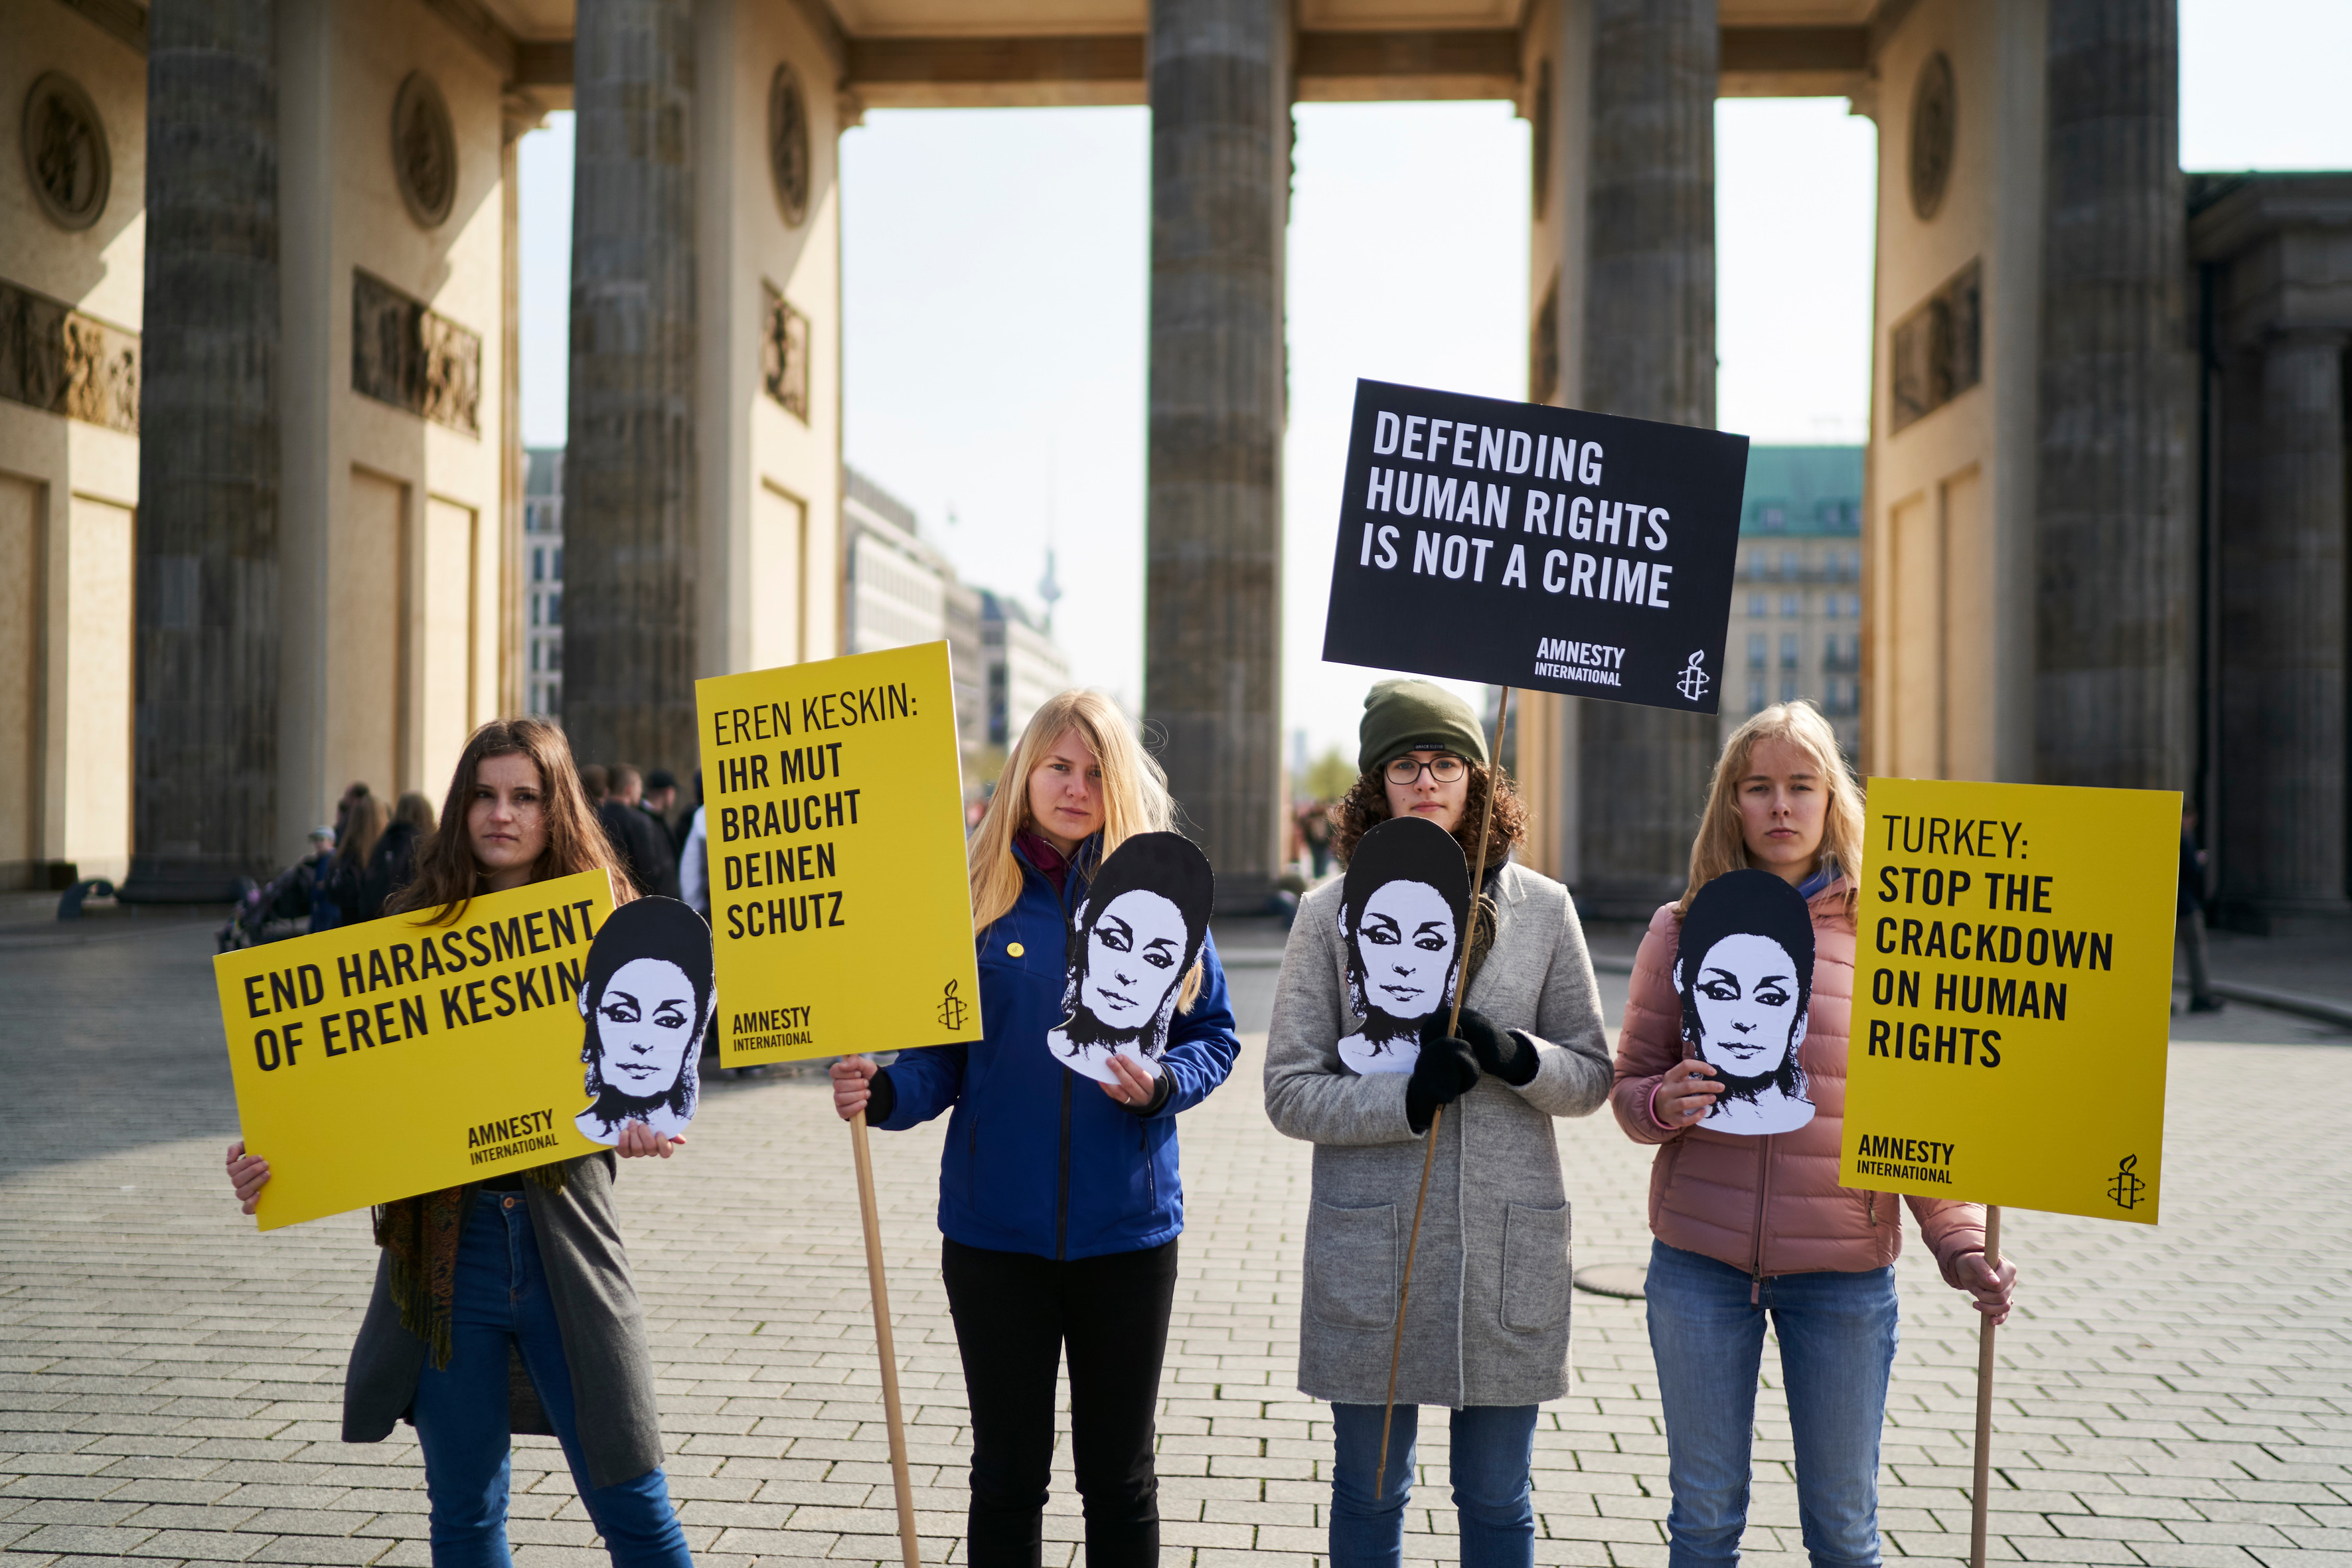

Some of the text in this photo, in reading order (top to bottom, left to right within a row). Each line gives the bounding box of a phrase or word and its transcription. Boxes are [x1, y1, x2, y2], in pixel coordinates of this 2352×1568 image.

[1373, 410, 1603, 486] DEFENDING
[1366, 466, 1670, 551] HUMAN RIGHTS
[1360, 522, 1673, 609] IS NOT A CRIME
[1534, 661, 1622, 686] INTERNATIONAL
[1536, 637, 1626, 669] AMNESTY
[714, 682, 917, 746] EREN KESKIN:
[718, 742, 842, 794] IHR MUT
[721, 789, 861, 842] BRAUCHT
[1882, 815, 2028, 860] TURKEY:
[724, 842, 836, 891] DEINEN
[1878, 866, 2053, 914] STOP THE
[727, 890, 845, 939] SCHUTZ
[244, 900, 593, 1018] END HARASSMENT
[1876, 917, 2113, 971] CRACKDOWN
[254, 957, 583, 1071] OF EREN KESKIN
[1872, 968, 2067, 1021] ON HUMAN
[733, 1005, 811, 1035] AMNESTY
[734, 1030, 813, 1052] INTERNATIONAL
[1868, 1019, 2001, 1068] RIGHTS
[468, 1108, 553, 1149] AMNESTY
[470, 1133, 559, 1165] INTERNATIONAL
[1857, 1134, 1955, 1166] AMNESTY
[1857, 1159, 1952, 1184] INTERNATIONAL
